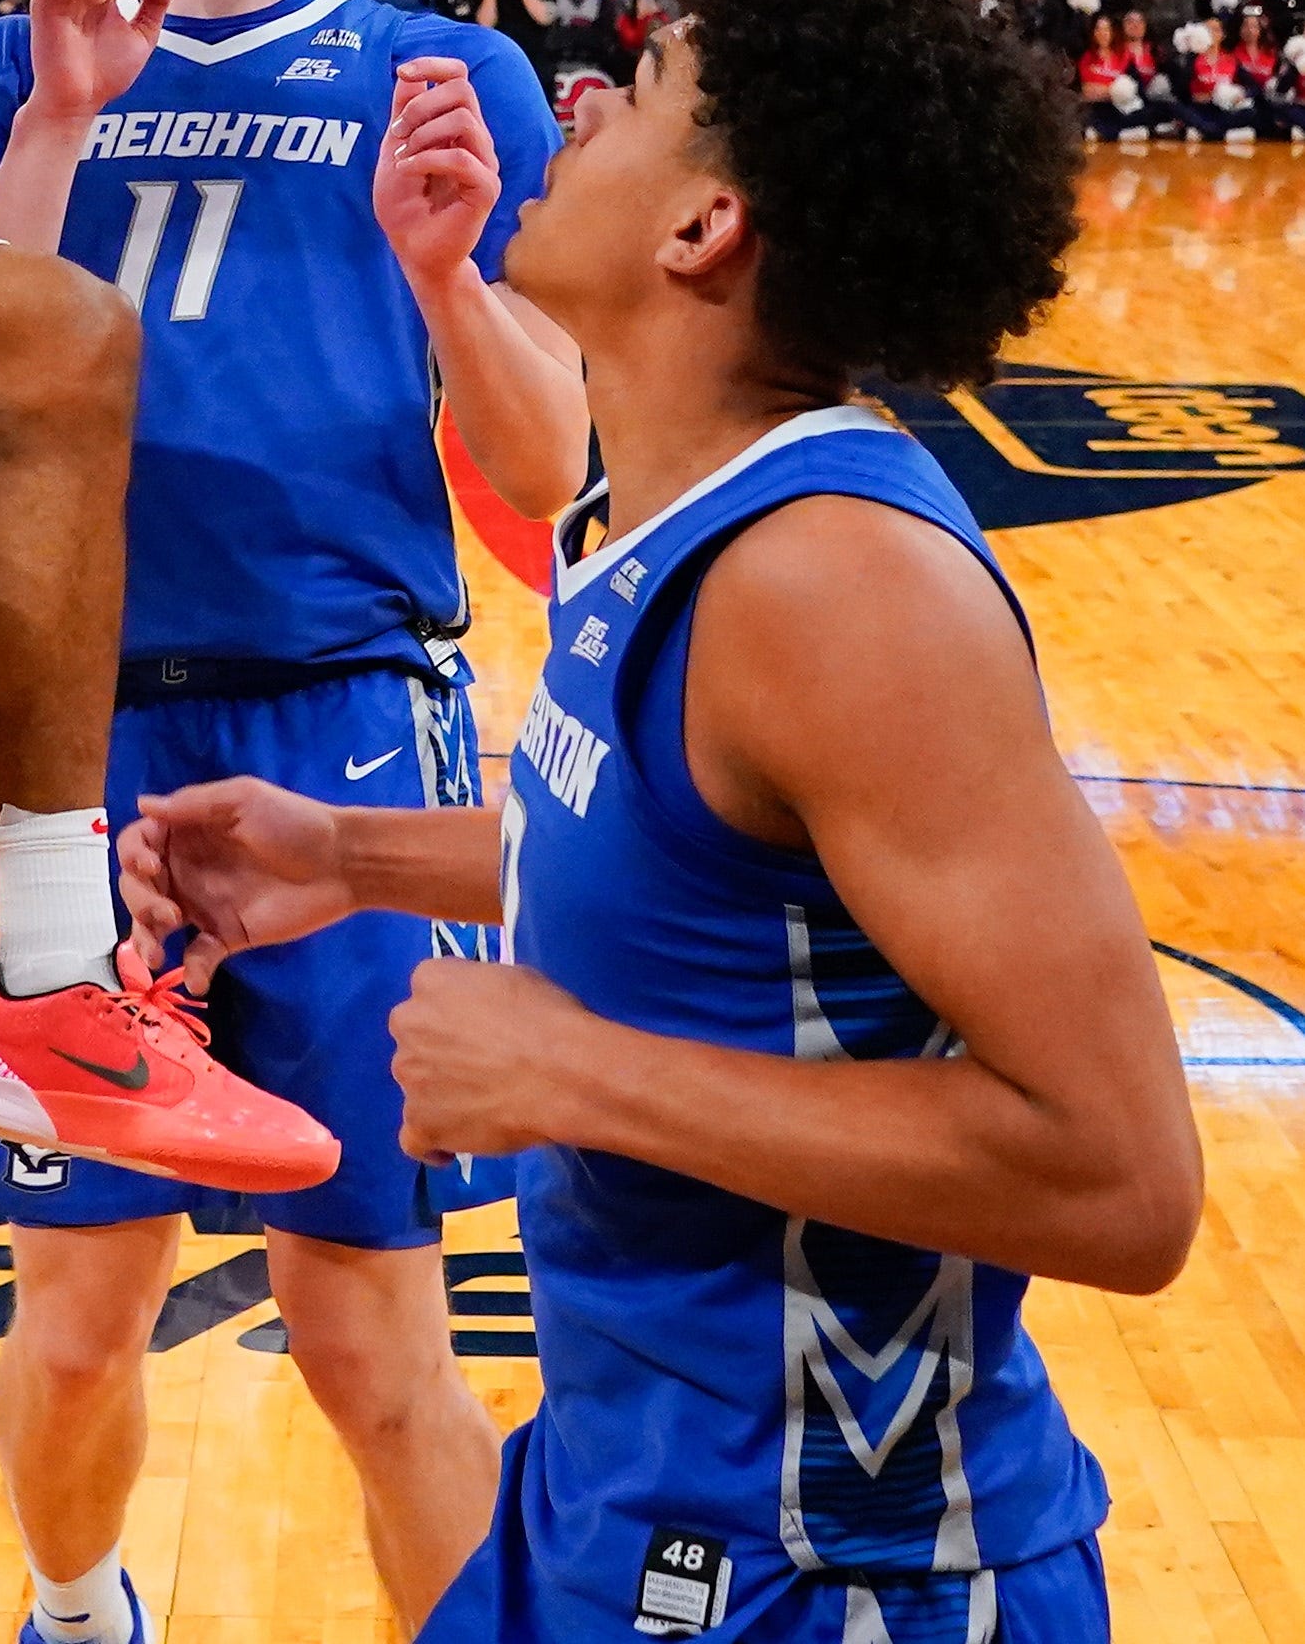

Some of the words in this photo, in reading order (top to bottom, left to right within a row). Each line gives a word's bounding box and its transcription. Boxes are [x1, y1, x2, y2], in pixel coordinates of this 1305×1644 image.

[79, 111, 363, 167] REIGHTON
[114, 179, 245, 322] 11
[521, 675, 612, 819] GHTON
[662, 1539, 705, 1571] 48
